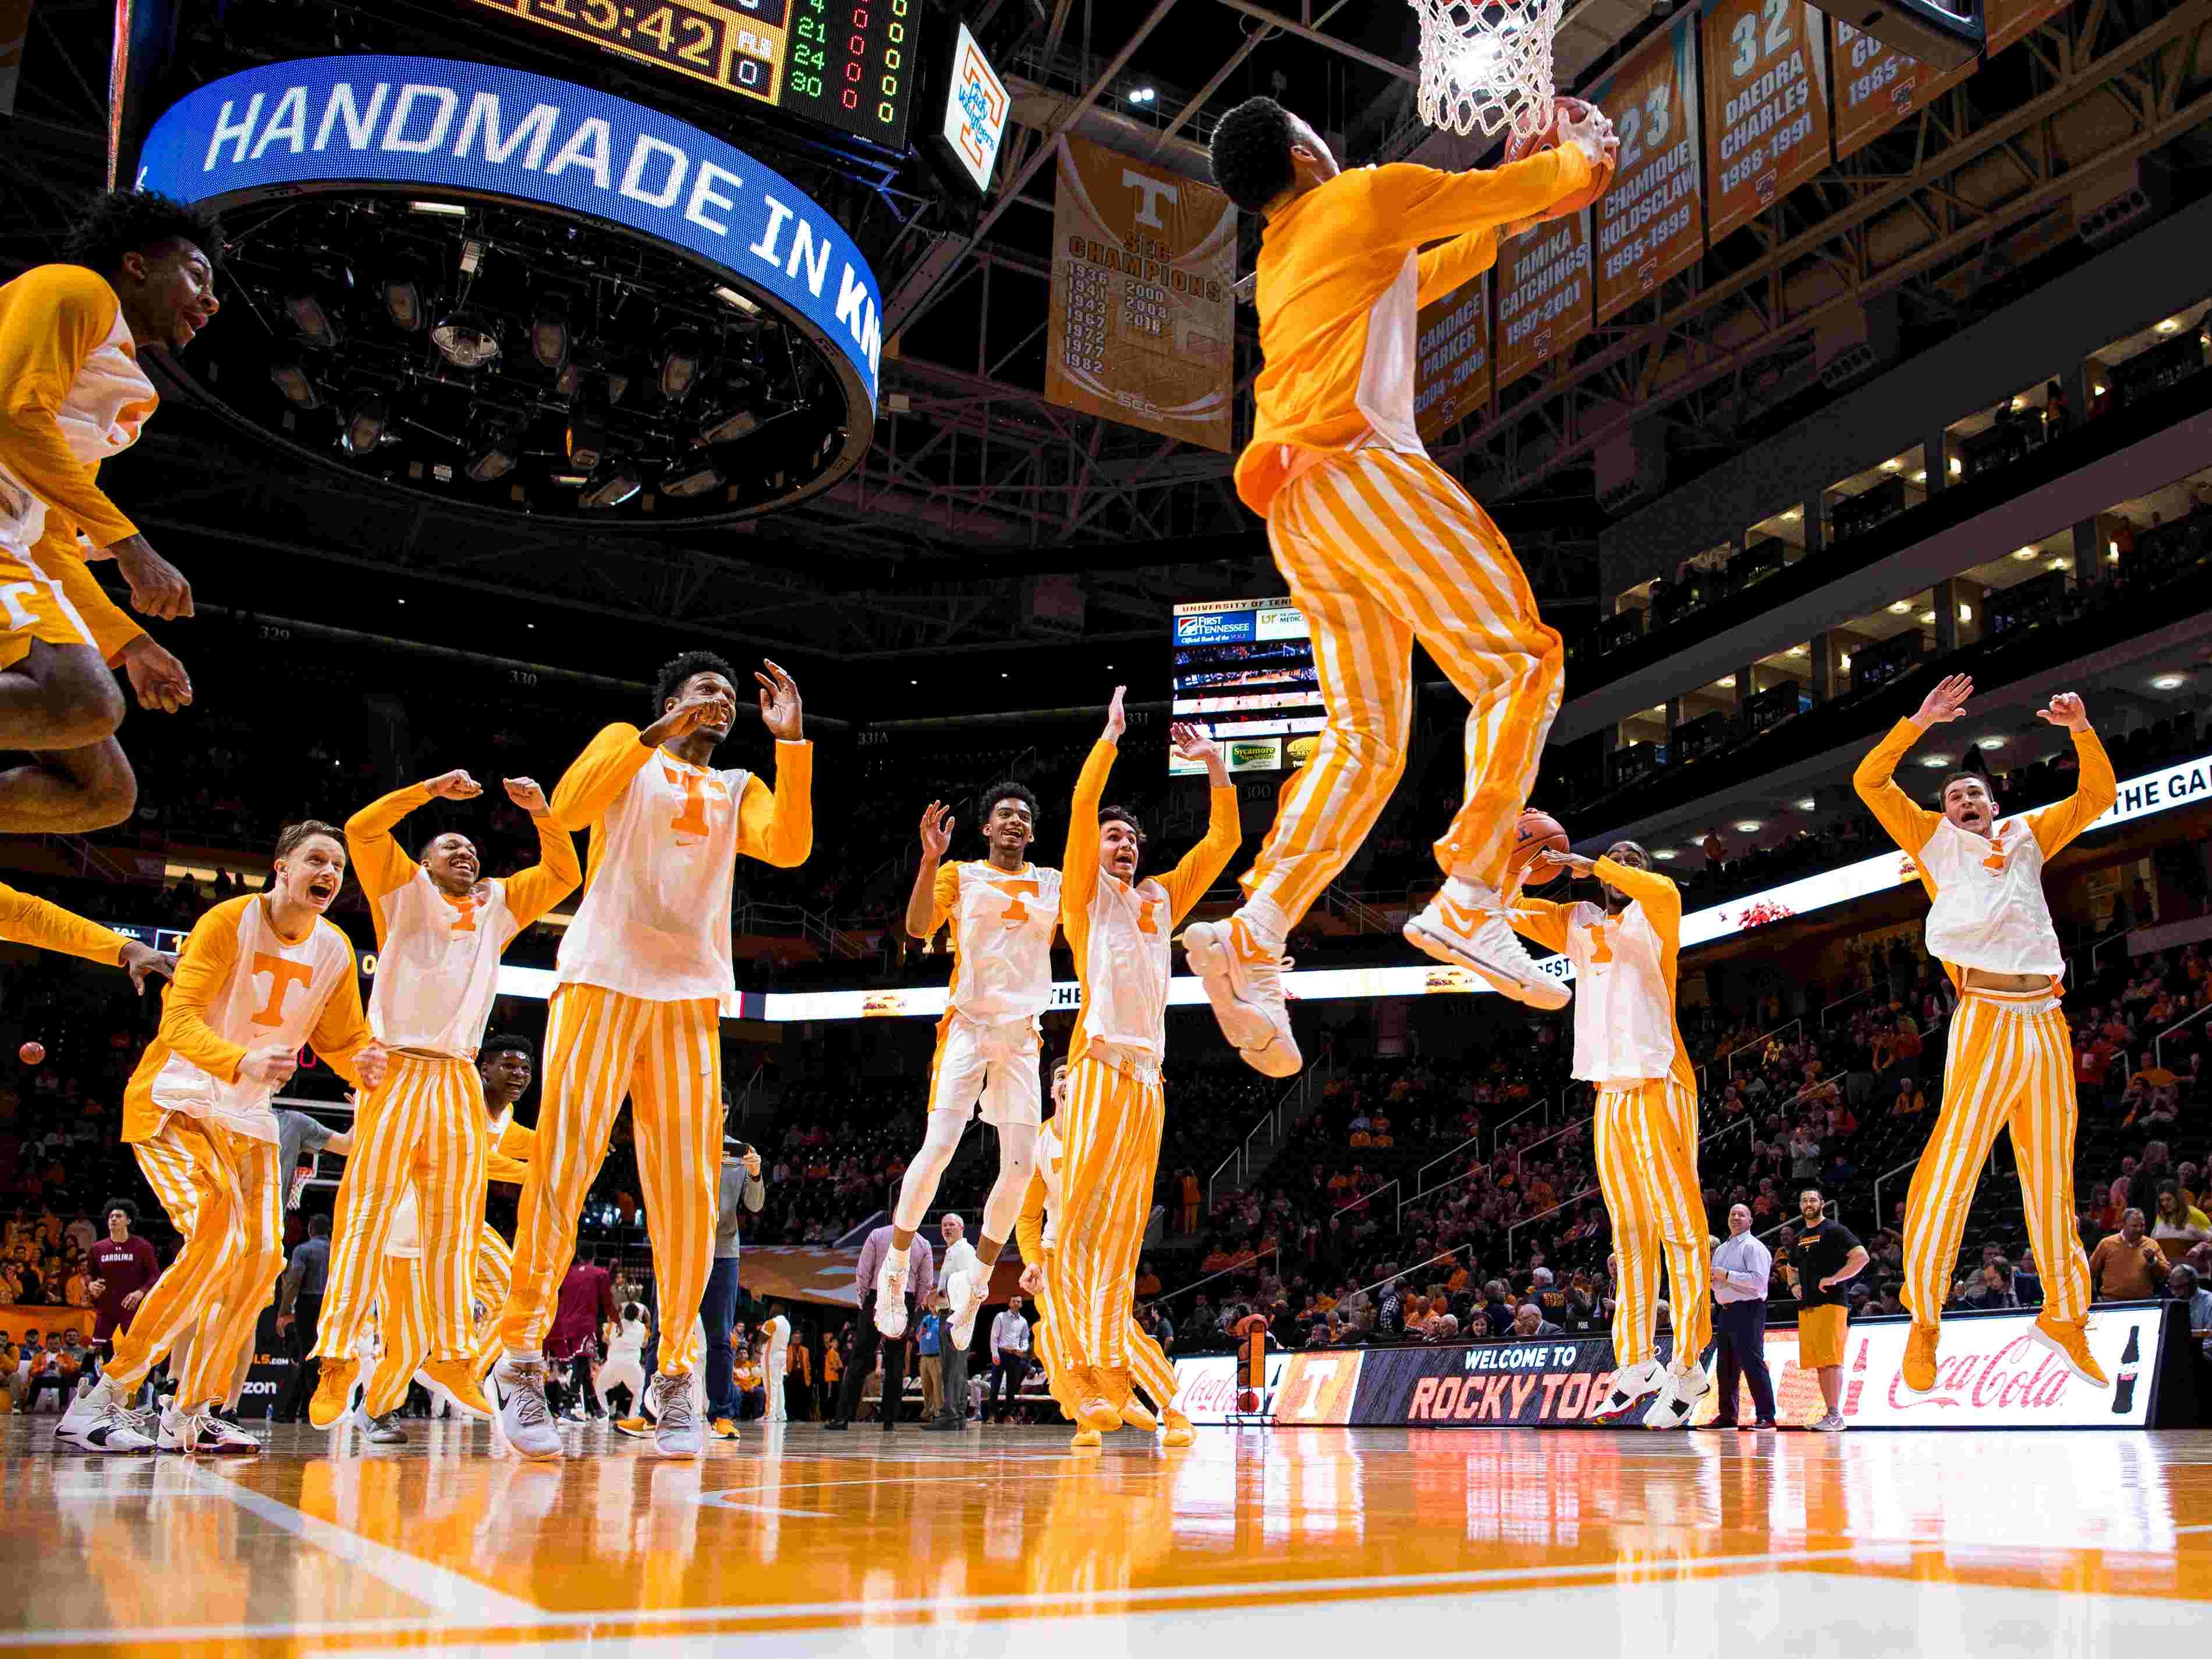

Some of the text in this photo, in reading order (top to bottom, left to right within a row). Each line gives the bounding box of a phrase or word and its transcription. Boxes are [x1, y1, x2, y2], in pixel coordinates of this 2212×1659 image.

[798, 16, 901, 69] 21 0 0
[853, 9, 868, 28] 0
[889, 22, 903, 42] 0
[1731, 0, 1793, 79] 32
[739, 59, 757, 85] 0
[795, 43, 896, 96] 24 0 0
[1725, 47, 1804, 126] DAEDRA
[843, 88, 857, 109] 0
[878, 102, 894, 123] 0
[1619, 84, 1671, 174] 23
[1721, 76, 1809, 159] CHARLES
[1605, 140, 1690, 219] CHAMIQUE
[1721, 111, 1812, 196] 1988-1991
[204, 83, 743, 236] HANDMADE
[750, 194, 831, 299] IN
[1122, 168, 1178, 229] T
[1600, 161, 1698, 253] HOLDSCLAW
[1069, 235, 1222, 304] CHAMPIONS
[1513, 227, 1571, 285] TAMIKA
[1605, 204, 1690, 280] 1995-1999
[1499, 242, 1589, 321] CATCHINGS
[1419, 293, 1481, 358] CANDACE
[1506, 279, 1581, 345] 1997-2001
[1423, 324, 1476, 381] PARKER
[1182, 600, 1247, 612] UNIVERSITY
[1251, 598, 1263, 608] OF
[1197, 623, 1250, 634] TENNESSEE
[1198, 616, 1223, 626] FIRST
[1233, 746, 1275, 757] Sycamore
[663, 768, 730, 837] T
[2168, 765, 2212, 798] GA
[987, 879, 1040, 922] T
[251, 951, 313, 1027] T
[101, 1253, 133, 1263] CAROLINA
[253, 1353, 289, 1365] LS.COM
[1465, 1346, 1577, 1370] WELCOME TO
[242, 1381, 276, 1394] zon
[1298, 1359, 1339, 1419] T
[1408, 1374, 1537, 1420] ROCKY
